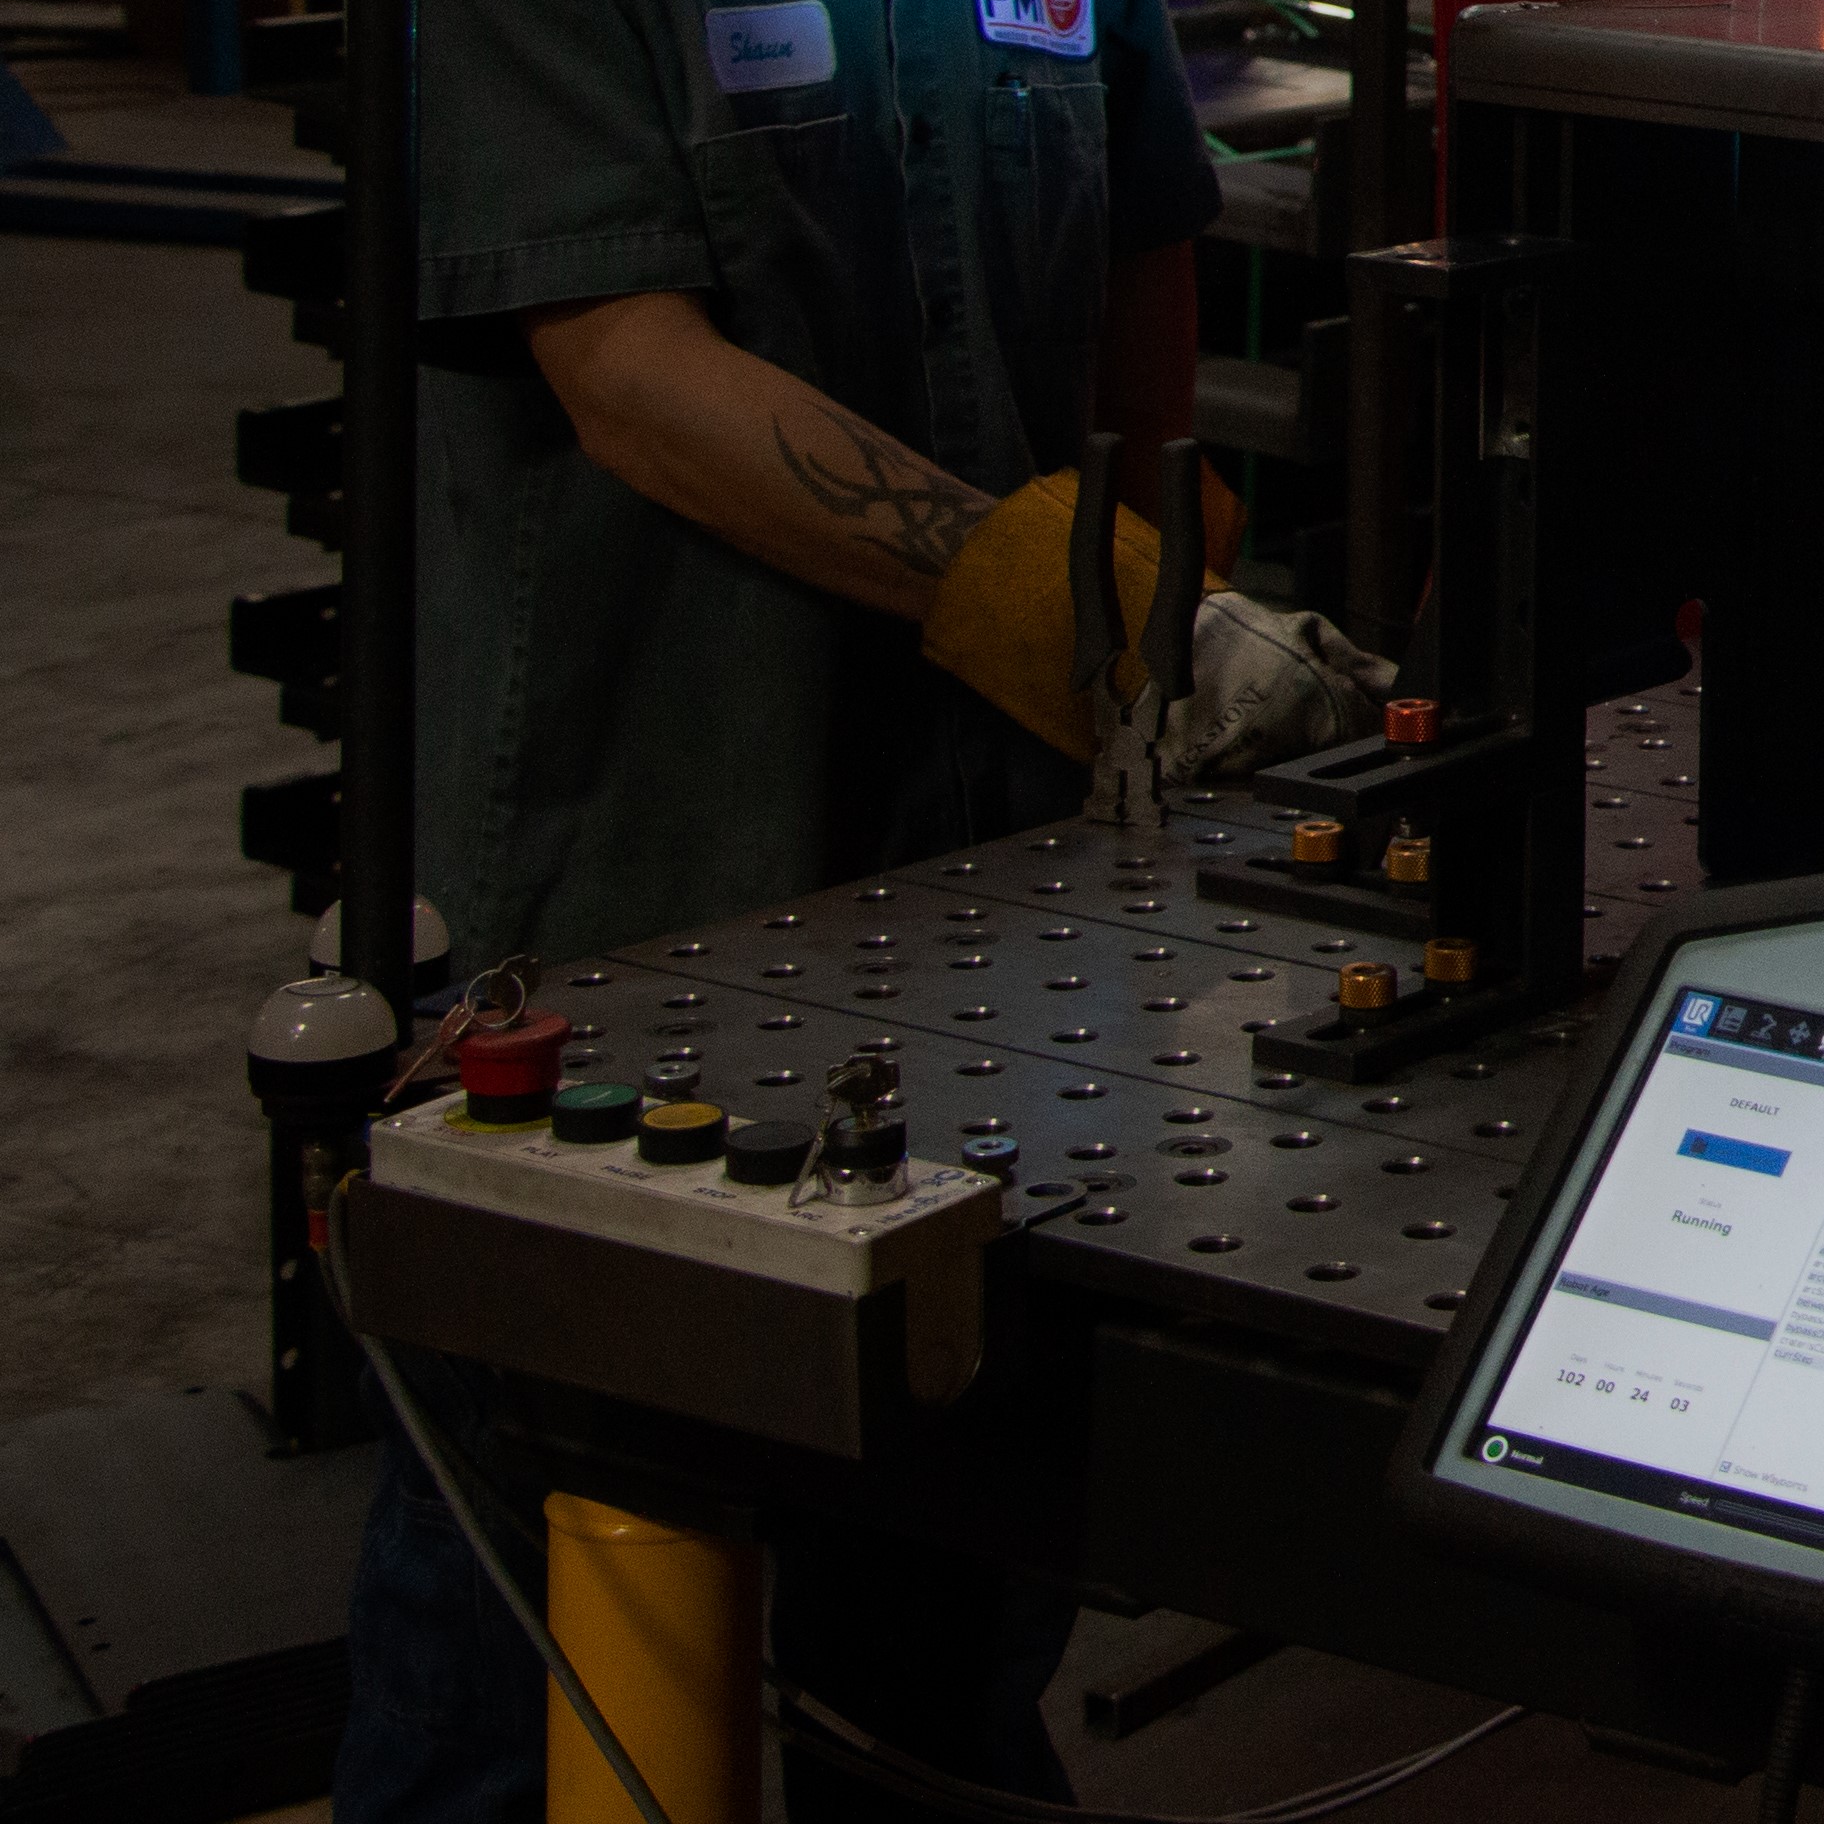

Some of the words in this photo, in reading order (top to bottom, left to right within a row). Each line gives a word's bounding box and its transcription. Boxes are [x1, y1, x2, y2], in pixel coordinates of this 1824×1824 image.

[1727, 1097, 1781, 1117] DEFAULT
[1670, 1210, 1733, 1237] Running
[1555, 1368, 1587, 1387] 102
[1593, 1377, 1617, 1395] 00
[1628, 1386, 1652, 1404] 24
[1667, 1396, 1691, 1414] 03
